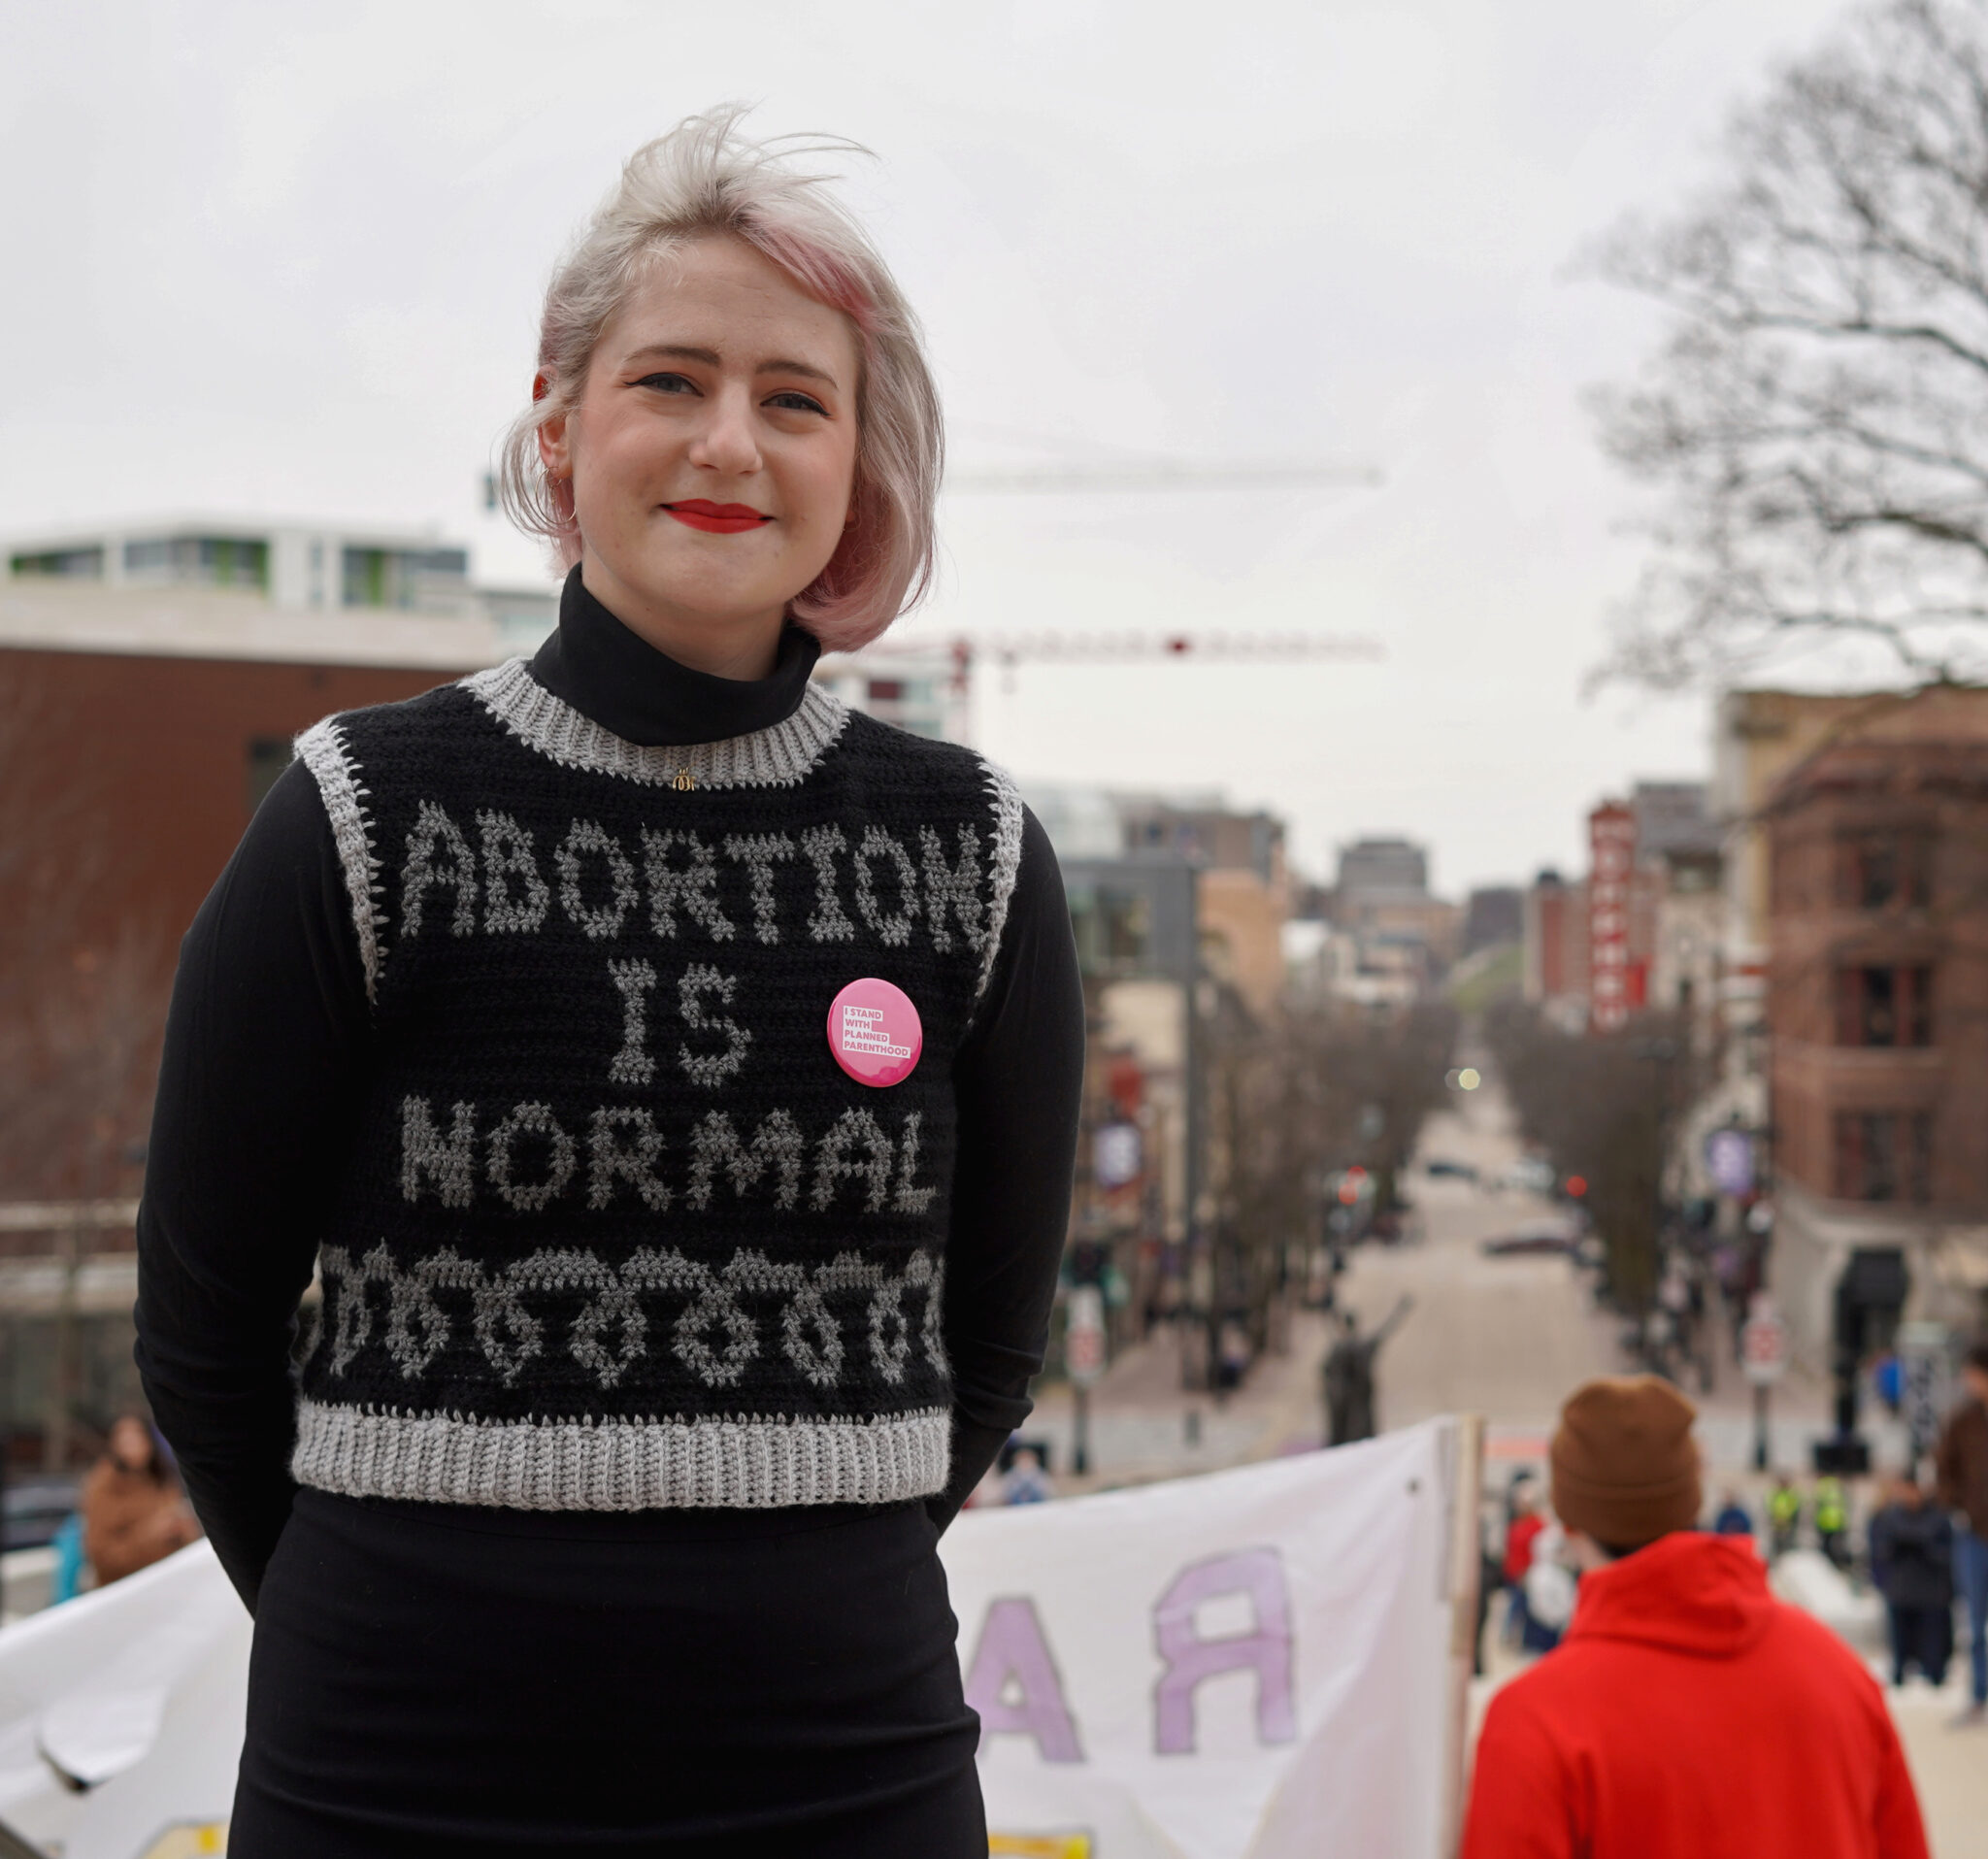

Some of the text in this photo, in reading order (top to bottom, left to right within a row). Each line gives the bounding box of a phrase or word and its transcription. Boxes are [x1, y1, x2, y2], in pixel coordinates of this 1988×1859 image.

[400, 799, 991, 955] ABORTION
[850, 1008, 882, 1019] STAND
[607, 955, 752, 1088] IS
[845, 1018, 871, 1029] WITH
[844, 1029, 888, 1043] PLANNED
[844, 1041, 909, 1056] PARENTHOOD
[400, 1093, 939, 1214] NORMAL
